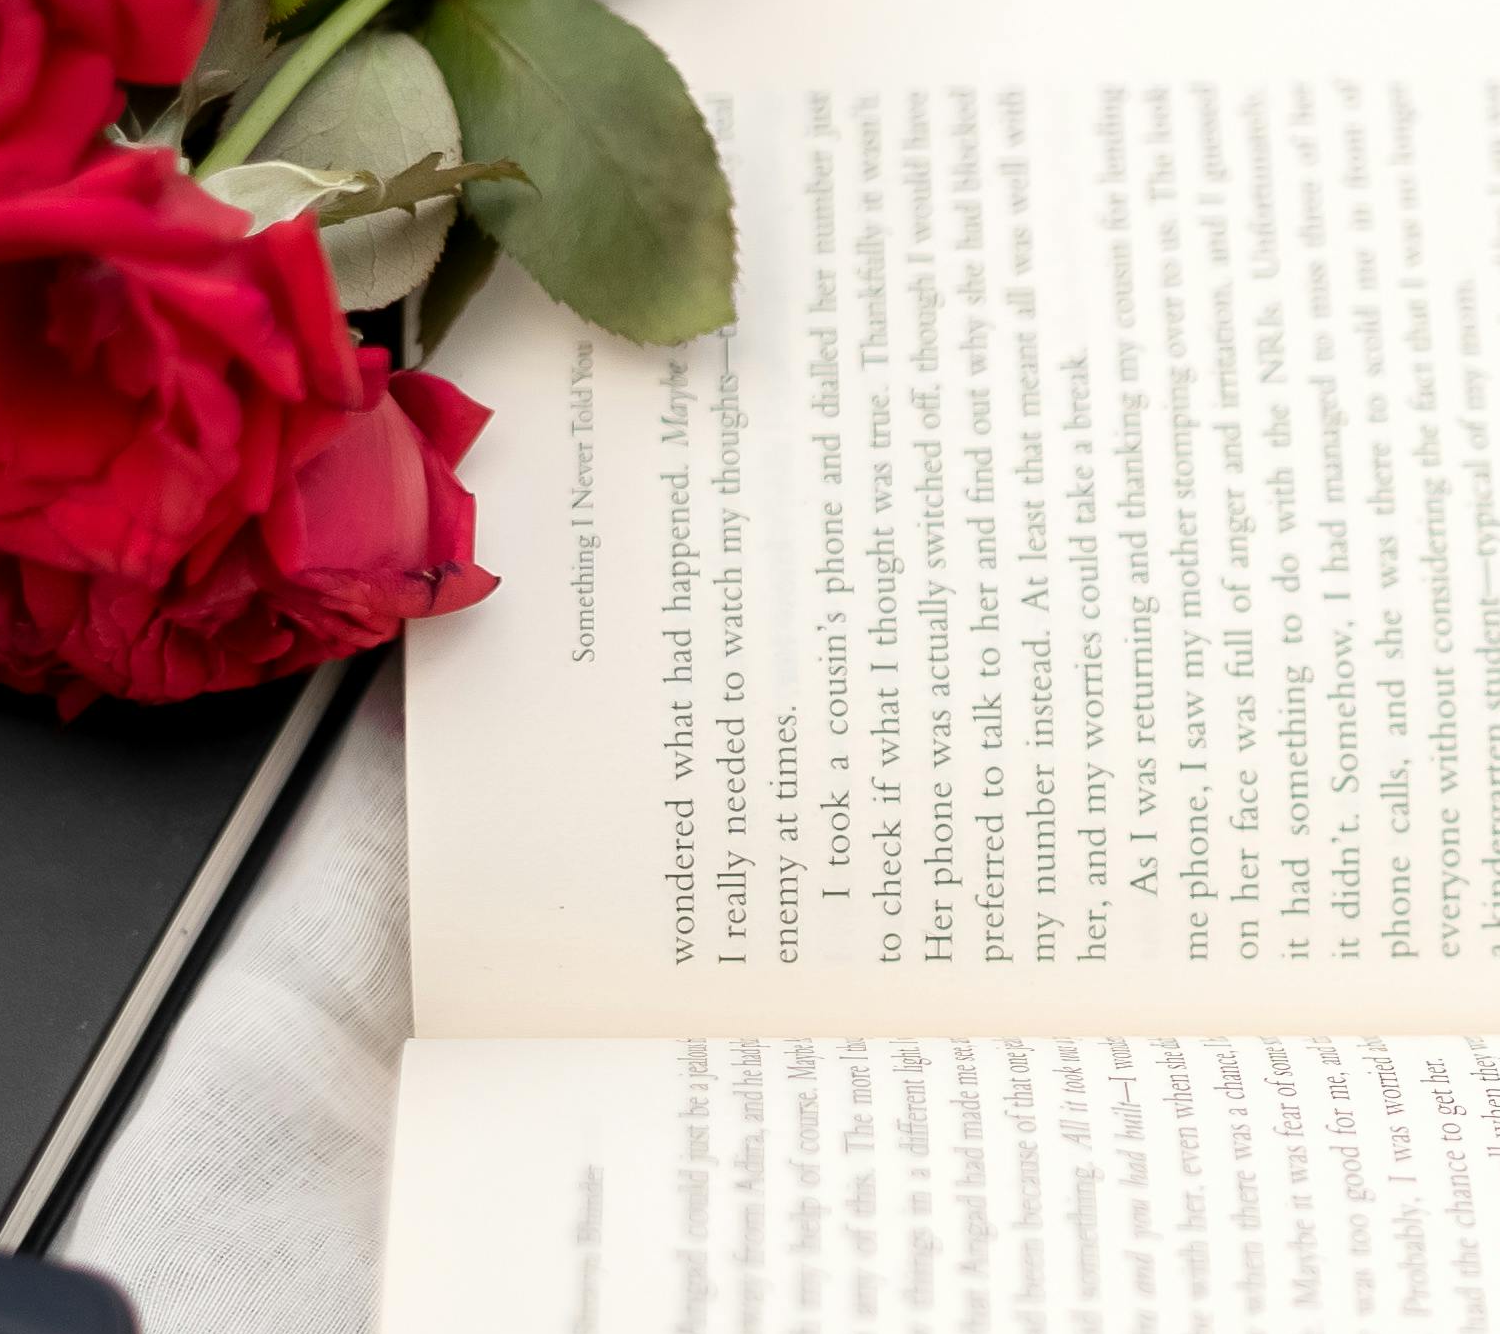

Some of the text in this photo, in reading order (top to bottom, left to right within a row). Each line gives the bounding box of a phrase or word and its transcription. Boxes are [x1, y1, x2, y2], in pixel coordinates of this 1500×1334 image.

[570, 338, 594, 387] You
[570, 389, 594, 438] Told
[572, 441, 594, 510] Never
[812, 433, 842, 485] and
[722, 508, 750, 554] my
[814, 502, 854, 595] phone
[570, 535, 601, 662] Something
[712, 567, 743, 657] watch
[660, 358, 700, 965] wondered what had happened. Maybe
[723, 672, 744, 702] to
[912, 440, 963, 962] Her phone was actually switched
[963, 446, 1013, 963] preferred to talk to her and find
[1066, 465, 1115, 961] her, and my worries could take
[1116, 531, 1160, 896] As I was returning and
[1326, 622, 1360, 793] Somehow,
[716, 718, 746, 835] needed
[830, 755, 849, 770] a
[865, 527, 905, 963] to check if what I thought
[1017, 500, 1065, 962] my number instead. At least
[1168, 508, 1218, 960] me phone, I saw my mother
[1220, 576, 1259, 960] on her face was full of
[1277, 613, 1314, 960] it had something to
[1373, 609, 1419, 959] phone calls, and she
[768, 707, 808, 963] enemy at times.
[820, 790, 850, 866] took
[1428, 667, 1470, 959] everyone without
[716, 851, 756, 938] really
[822, 889, 850, 899] I
[1332, 938, 1360, 959] it
[719, 955, 746, 963] I
[1420, 1059, 1467, 1141] to get her.
